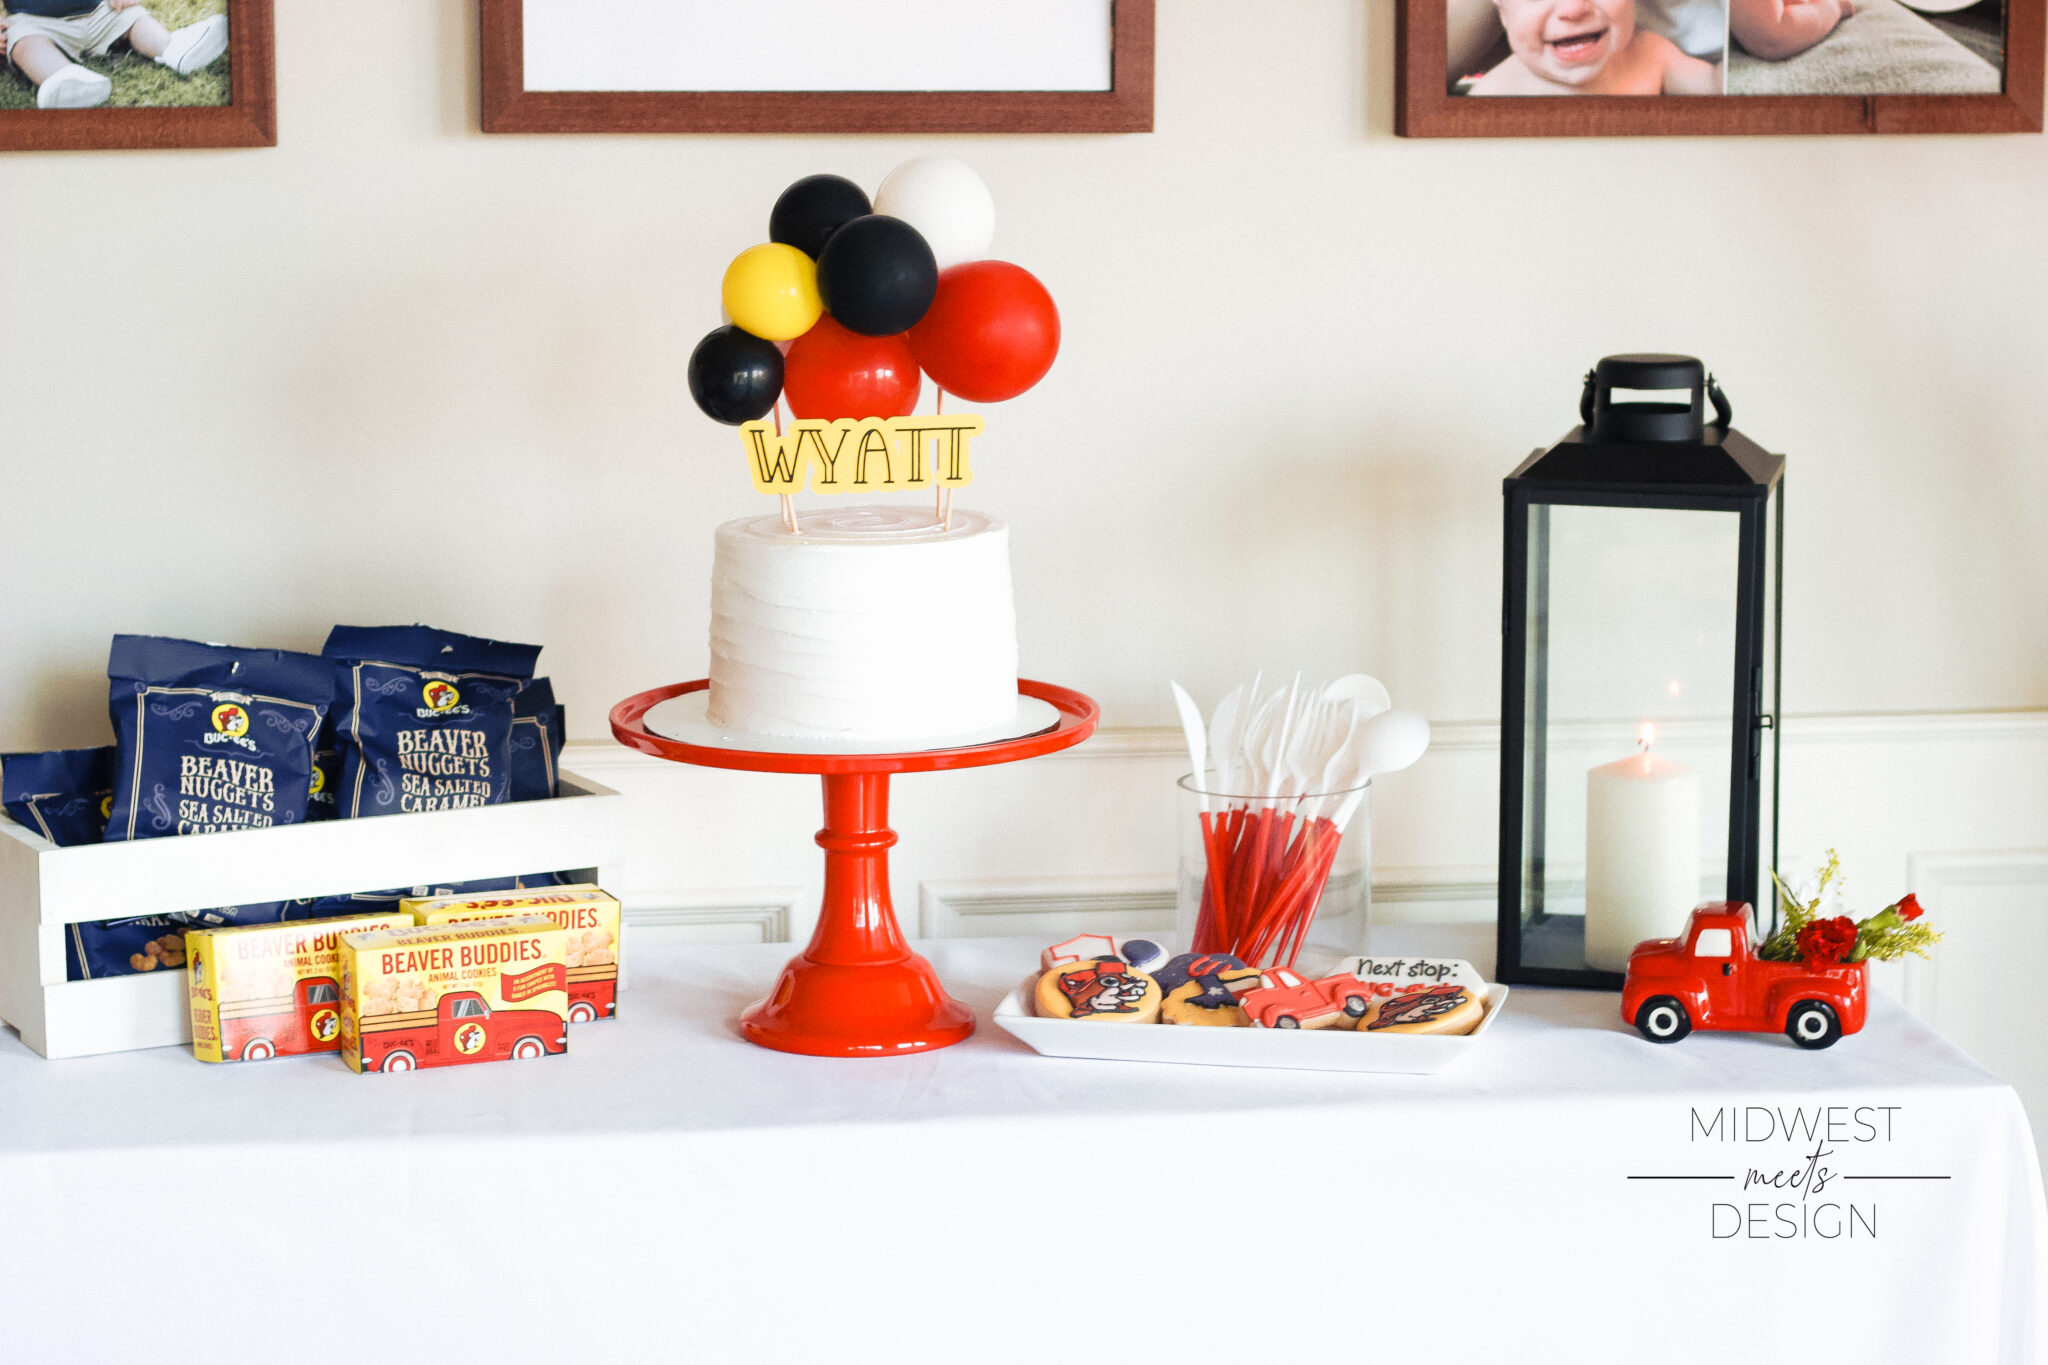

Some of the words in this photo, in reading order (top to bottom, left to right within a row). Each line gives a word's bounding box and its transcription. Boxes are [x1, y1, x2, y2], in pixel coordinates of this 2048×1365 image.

[750, 426, 976, 484] WYATT
[397, 729, 489, 759] BEAVER
[181, 755, 275, 793] BEAVER
[399, 752, 491, 778] NUGGETS
[180, 776, 275, 812] NUGGETS
[401, 774, 431, 797] SEA
[434, 779, 491, 799] SALTED
[178, 799, 209, 824] SEA
[212, 805, 273, 828] SALTED
[238, 934, 307, 960] BEAVER
[397, 934, 451, 946] BEAVER
[456, 928, 519, 940] BUDDIES
[382, 948, 453, 975] BEAVER
[460, 939, 542, 967] BUDDIES
[428, 971, 459, 983] ANIMAL
[461, 967, 497, 980] COOKIES
